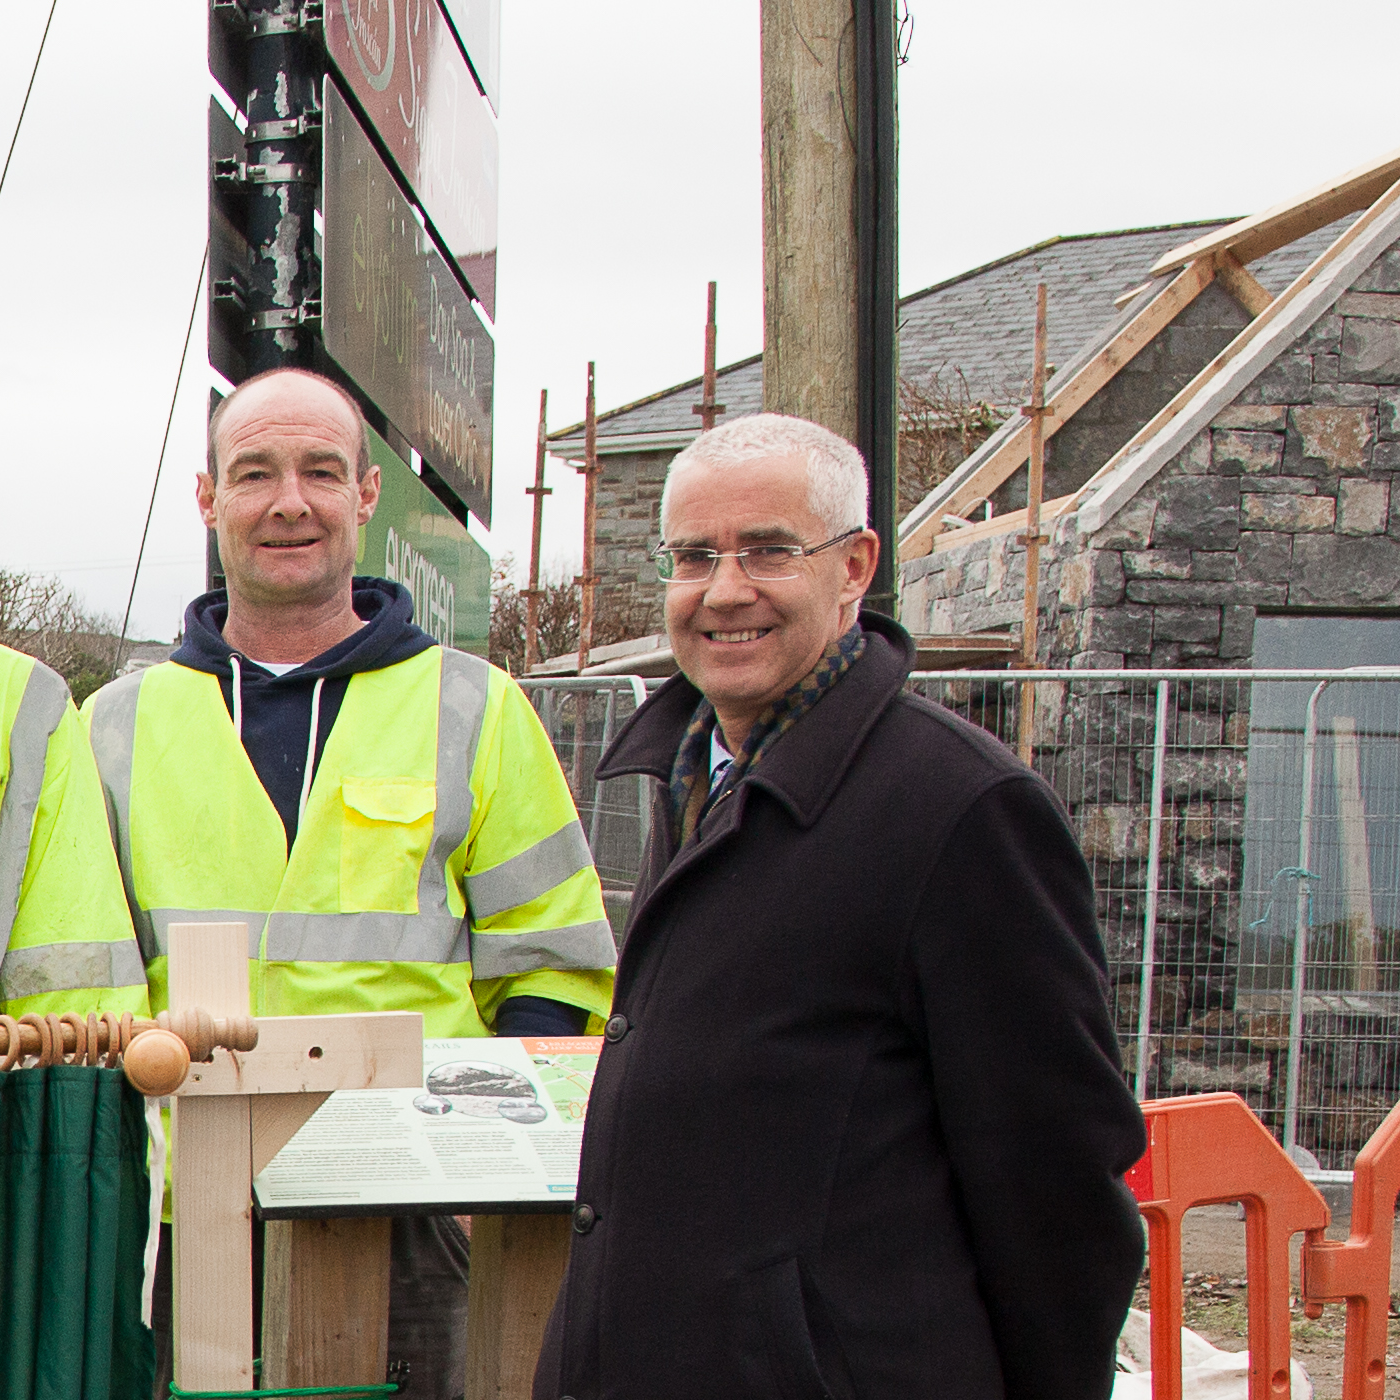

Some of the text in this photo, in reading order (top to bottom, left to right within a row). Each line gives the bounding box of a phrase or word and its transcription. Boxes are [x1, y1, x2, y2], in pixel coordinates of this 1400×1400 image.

[352, 157, 419, 381] elysium
[430, 274, 477, 398] Day Spa &
[430, 365, 454, 456] Laser
[535, 1041, 549, 1051] 3
